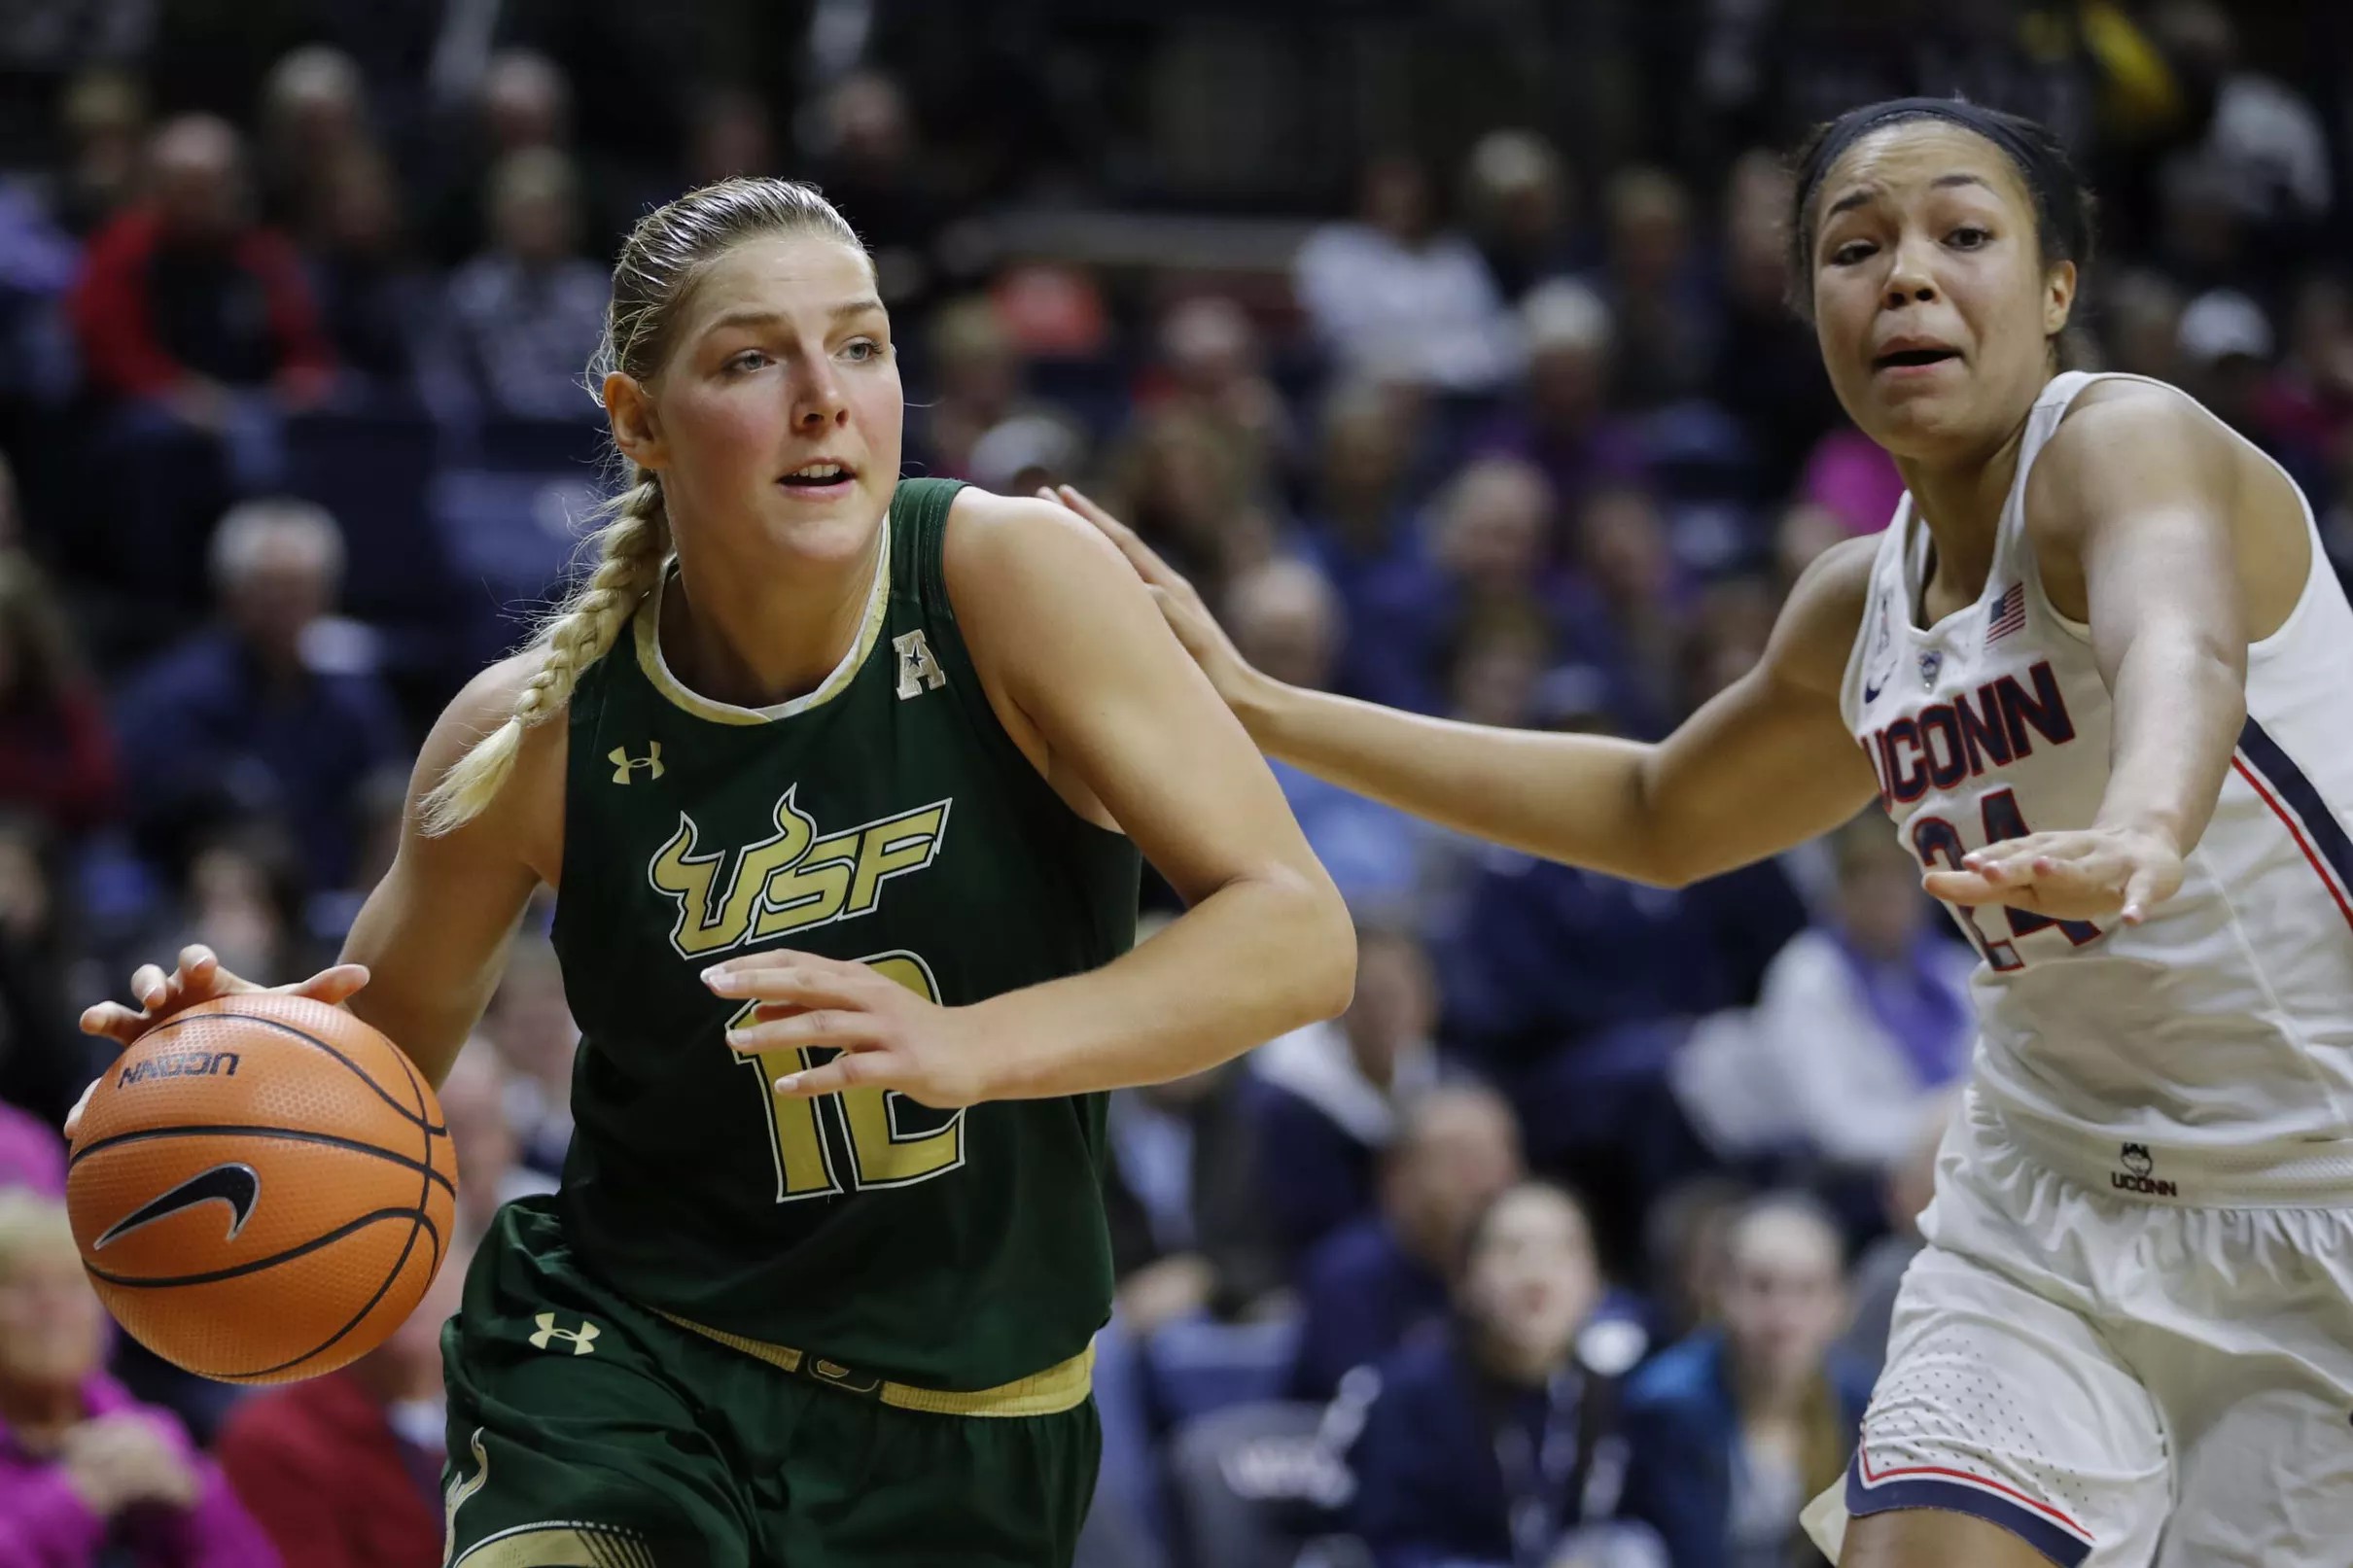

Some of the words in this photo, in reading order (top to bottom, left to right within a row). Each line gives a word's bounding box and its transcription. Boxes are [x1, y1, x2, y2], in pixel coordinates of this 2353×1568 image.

[1860, 660, 2076, 814] UCONN
[648, 782, 953, 960] USF
[117, 1051, 240, 1090] UCONN
[2110, 1170, 2178, 1198] UCONN
